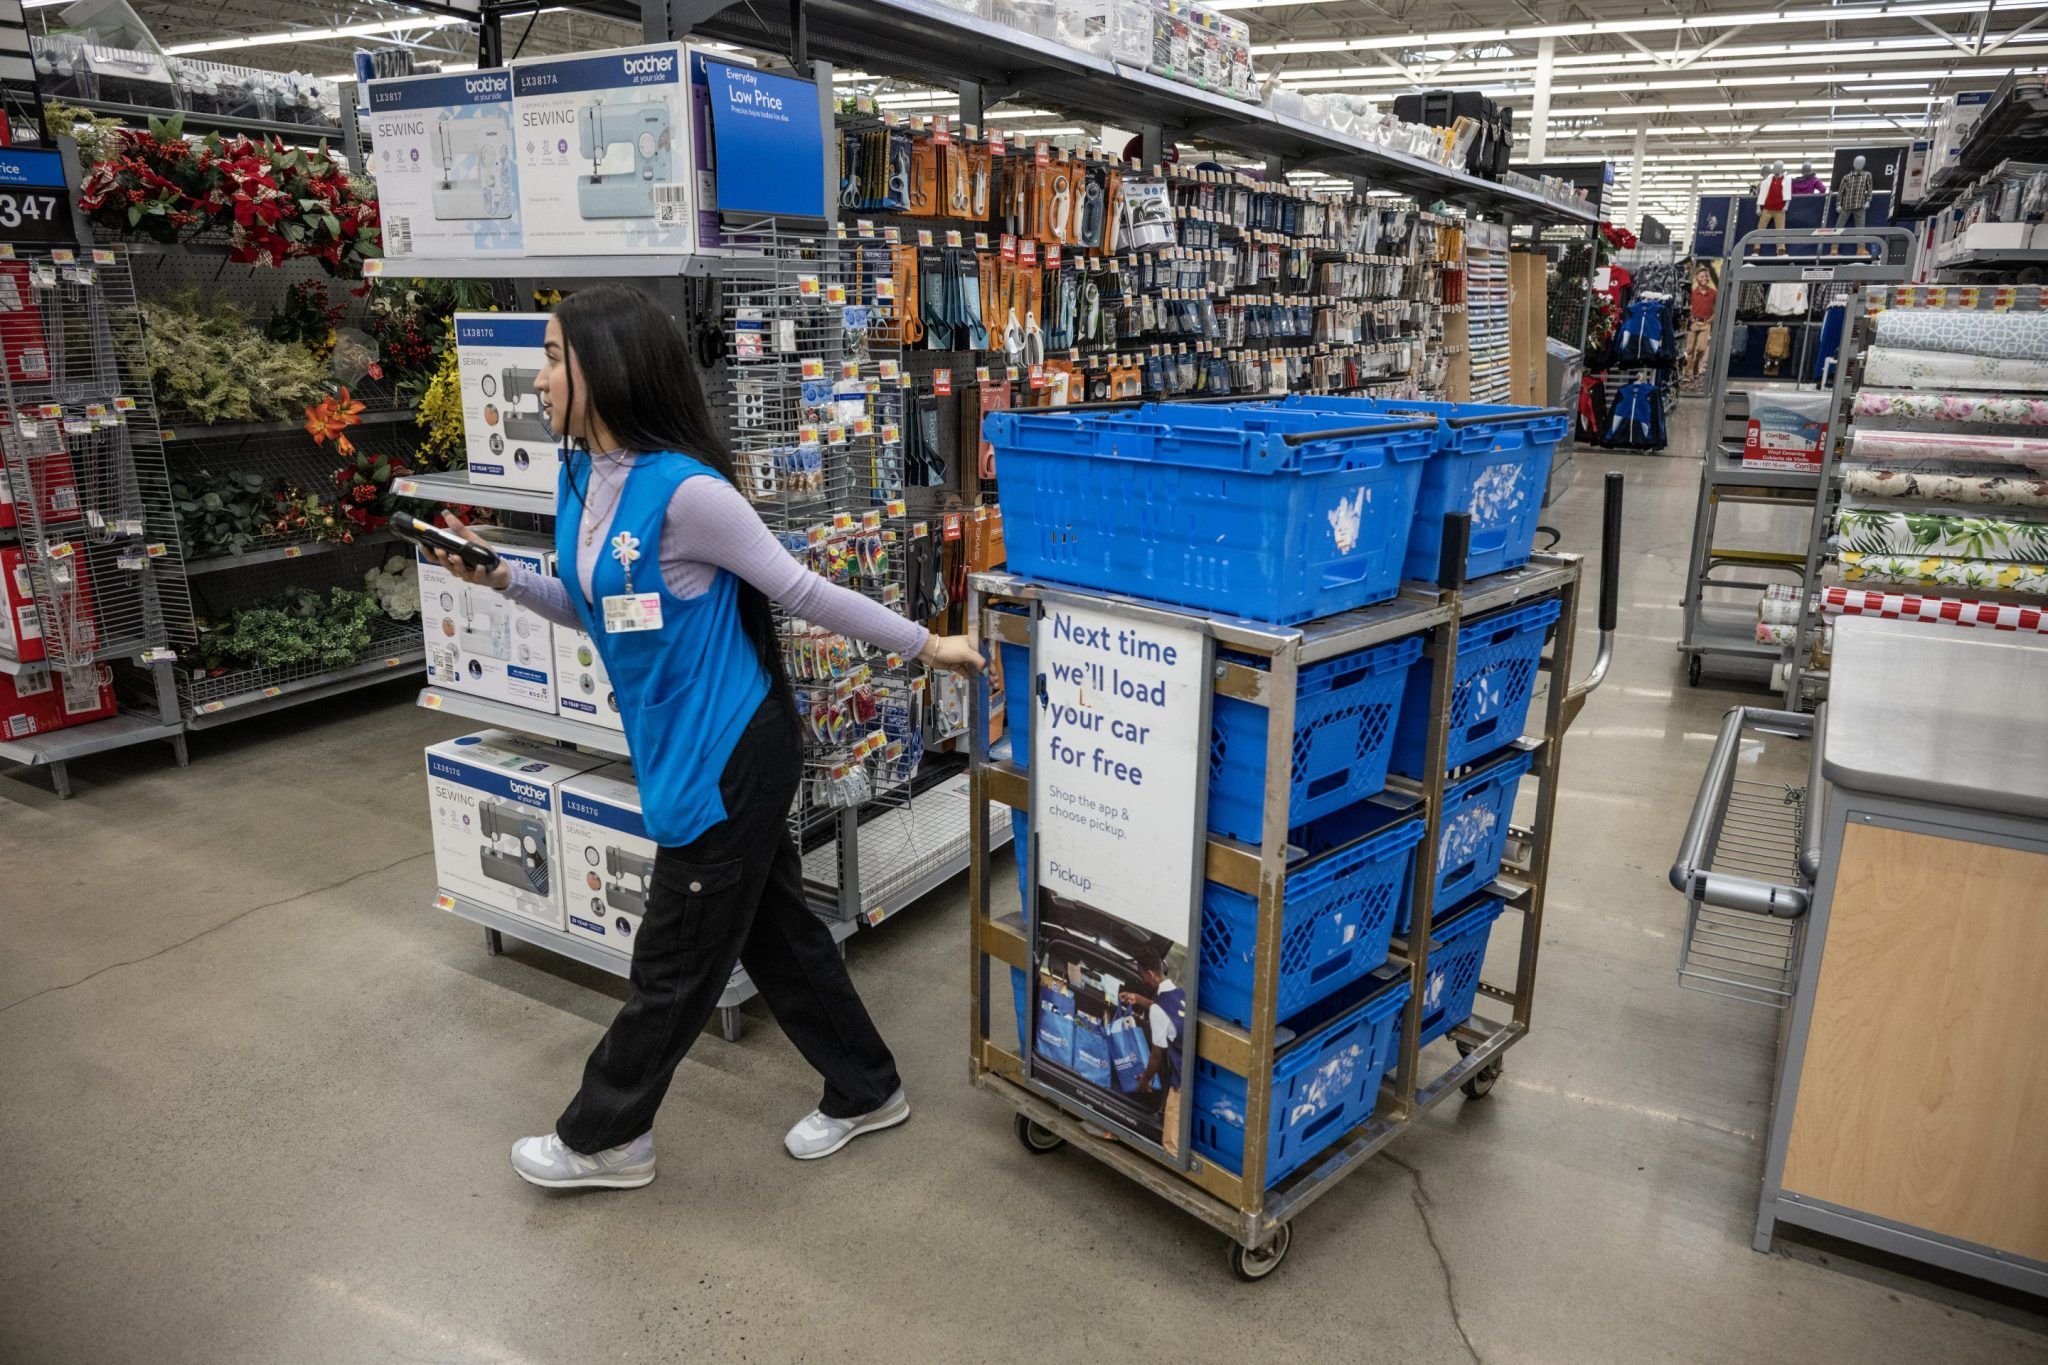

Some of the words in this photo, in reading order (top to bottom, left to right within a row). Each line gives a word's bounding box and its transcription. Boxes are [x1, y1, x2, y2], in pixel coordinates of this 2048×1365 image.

[623, 54, 674, 76] brother
[465, 76, 508, 95] brother
[521, 74, 558, 88] LX3817A
[726, 68, 758, 87] Everyday
[375, 91, 402, 104] LX3817
[729, 84, 752, 106] Low
[754, 89, 783, 111] Price
[522, 109, 575, 128] SEWING
[378, 121, 424, 138] SEWING
[0, 162, 20, 174] ice
[462, 328, 494, 338] LX3817G
[463, 357, 488, 366] SEWING
[1053, 612, 1111, 652] Next
[1118, 629, 1178, 666] time
[1113, 668, 1166, 708] load
[1050, 702, 1104, 733] your
[1111, 719, 1150, 745] car
[433, 762, 461, 777] LX3817G
[1050, 735, 1086, 768] for
[1092, 747, 1143, 786] free
[435, 786, 475, 808] SEWING
[509, 779, 547, 802] brother
[567, 800, 599, 817] LX3817G
[1049, 785, 1076, 806] Shop
[1078, 793, 1096, 810] the
[1098, 803, 1118, 820] app
[1121, 807, 1130, 822] &
[1049, 804, 1087, 825] choose
[1089, 817, 1127, 840] pickup.
[566, 824, 592, 840] SEWING
[1050, 860, 1092, 893] Pickup
